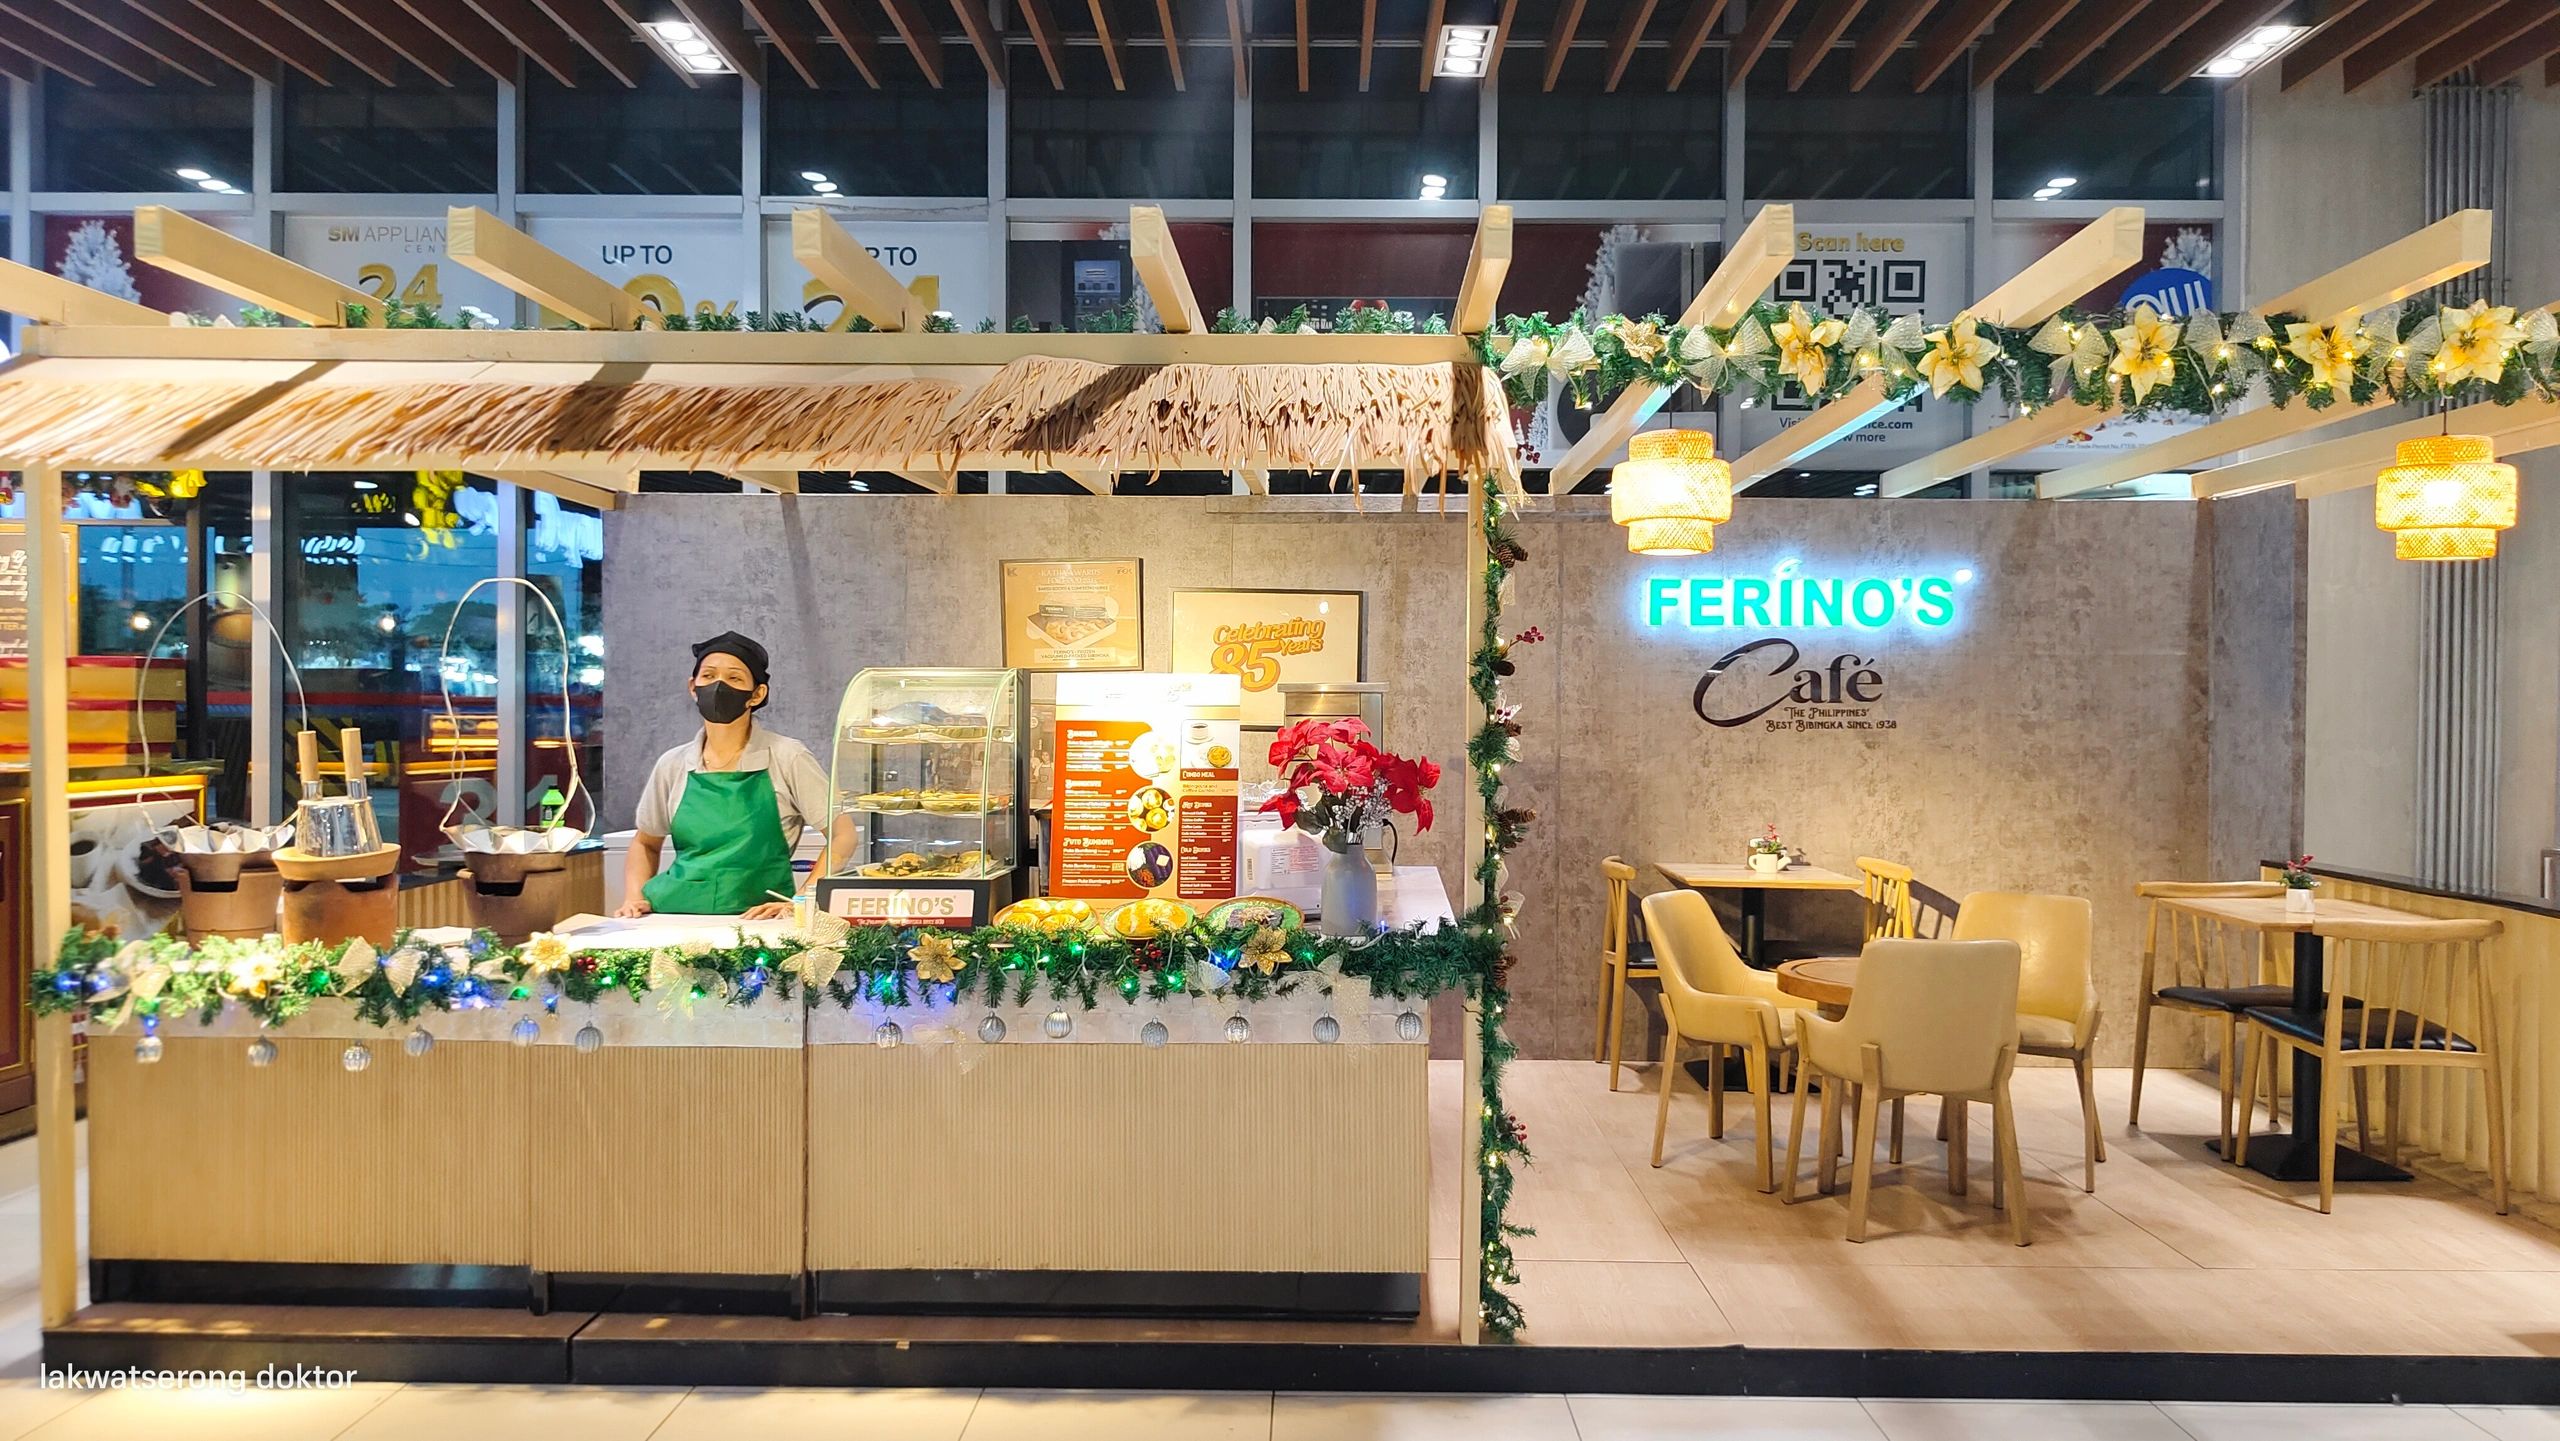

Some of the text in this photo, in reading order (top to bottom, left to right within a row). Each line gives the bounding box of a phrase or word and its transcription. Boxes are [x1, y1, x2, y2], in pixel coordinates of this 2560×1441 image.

[328, 226, 447, 242] SM APPLIAN
[1797, 232, 1905, 252] Scan here
[602, 245, 673, 265] UP TO
[884, 246, 918, 266] TO
[1855, 433, 1886, 442] more
[1648, 577, 1955, 628] FERINO'S
[1213, 617, 1326, 646] Celebrating
[1209, 640, 1281, 692] 85
[1280, 638, 1324, 656] Years
[1693, 638, 1884, 727] Café
[1875, 720, 1897, 729] 1938
[846, 896, 954, 916] FERINO'S
